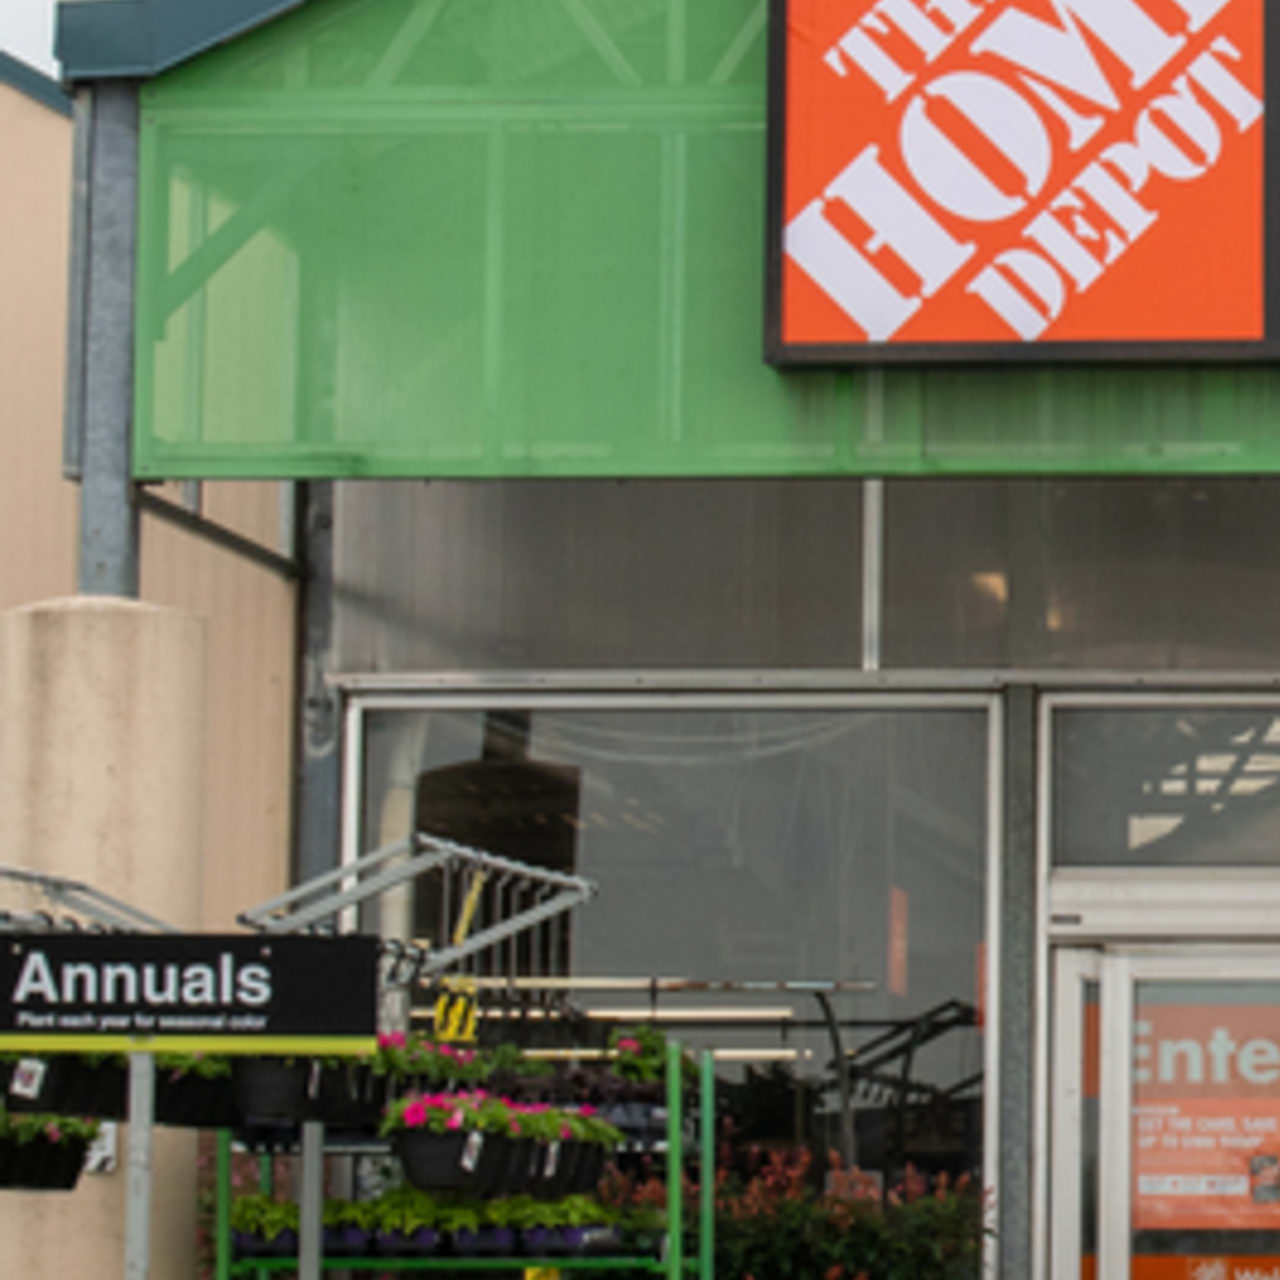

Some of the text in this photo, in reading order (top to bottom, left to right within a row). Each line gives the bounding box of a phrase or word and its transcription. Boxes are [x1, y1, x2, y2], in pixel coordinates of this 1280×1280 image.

[965, 35, 1264, 341] DEPOT
[12, 950, 273, 1006] Annuals
[16, 1012, 55, 1028] Plant
[58, 1012, 98, 1028] each
[134, 1012, 156, 1028] for
[158, 1012, 226, 1028] seasonal
[229, 1012, 269, 1028] color
